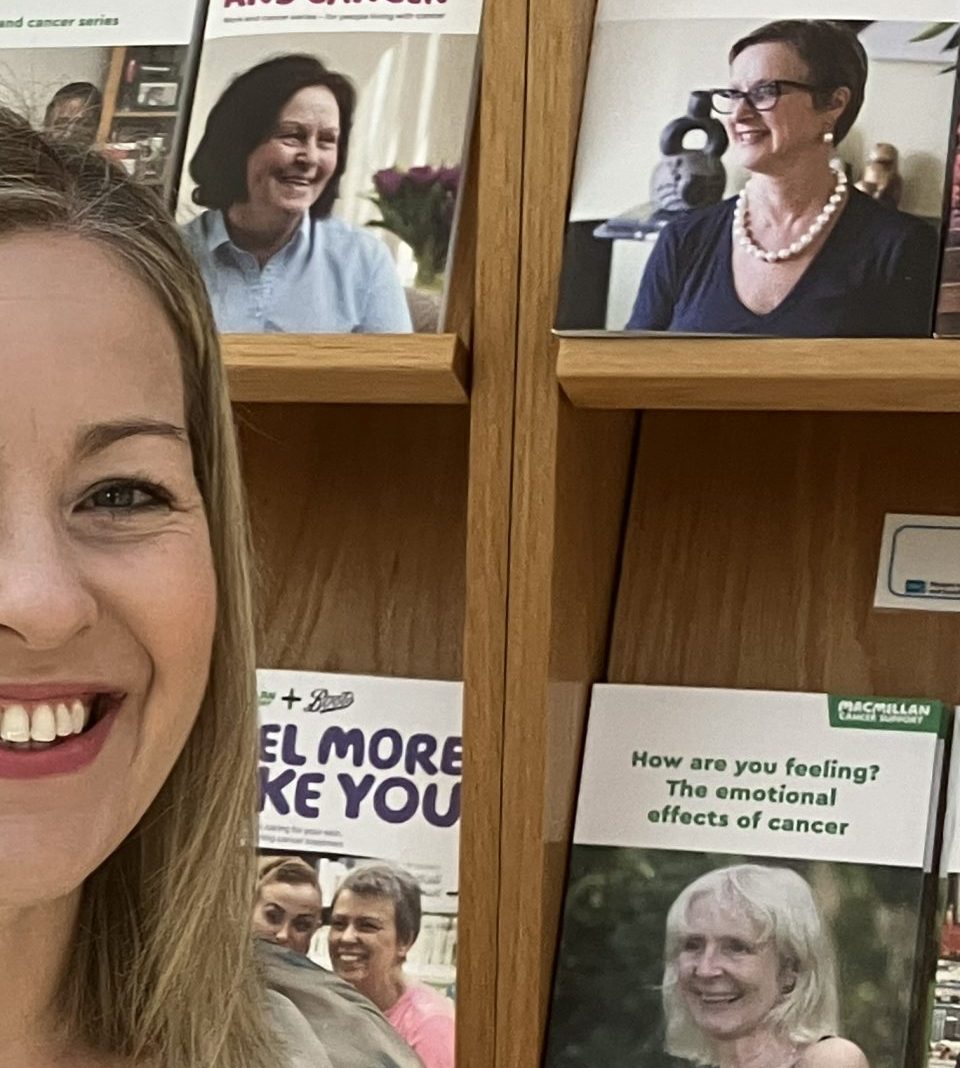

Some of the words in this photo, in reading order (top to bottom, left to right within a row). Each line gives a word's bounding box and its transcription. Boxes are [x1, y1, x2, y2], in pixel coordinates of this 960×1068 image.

[26, 17, 76, 29] cancer
[77, 14, 120, 28] series
[837, 700, 931, 717] MACMILLAN
[259, 723, 307, 767] EL
[317, 725, 463, 777] MORE
[631, 750, 684, 769] How
[689, 757, 728, 772] are
[733, 760, 778, 778] you
[784, 756, 881, 786] feeling?
[257, 765, 326, 819] KE
[336, 772, 462, 828] YOU
[665, 778, 708, 799] The
[715, 783, 838, 808] emotional
[647, 804, 730, 828] effects
[736, 810, 764, 830] of
[767, 816, 850, 836] cancer
